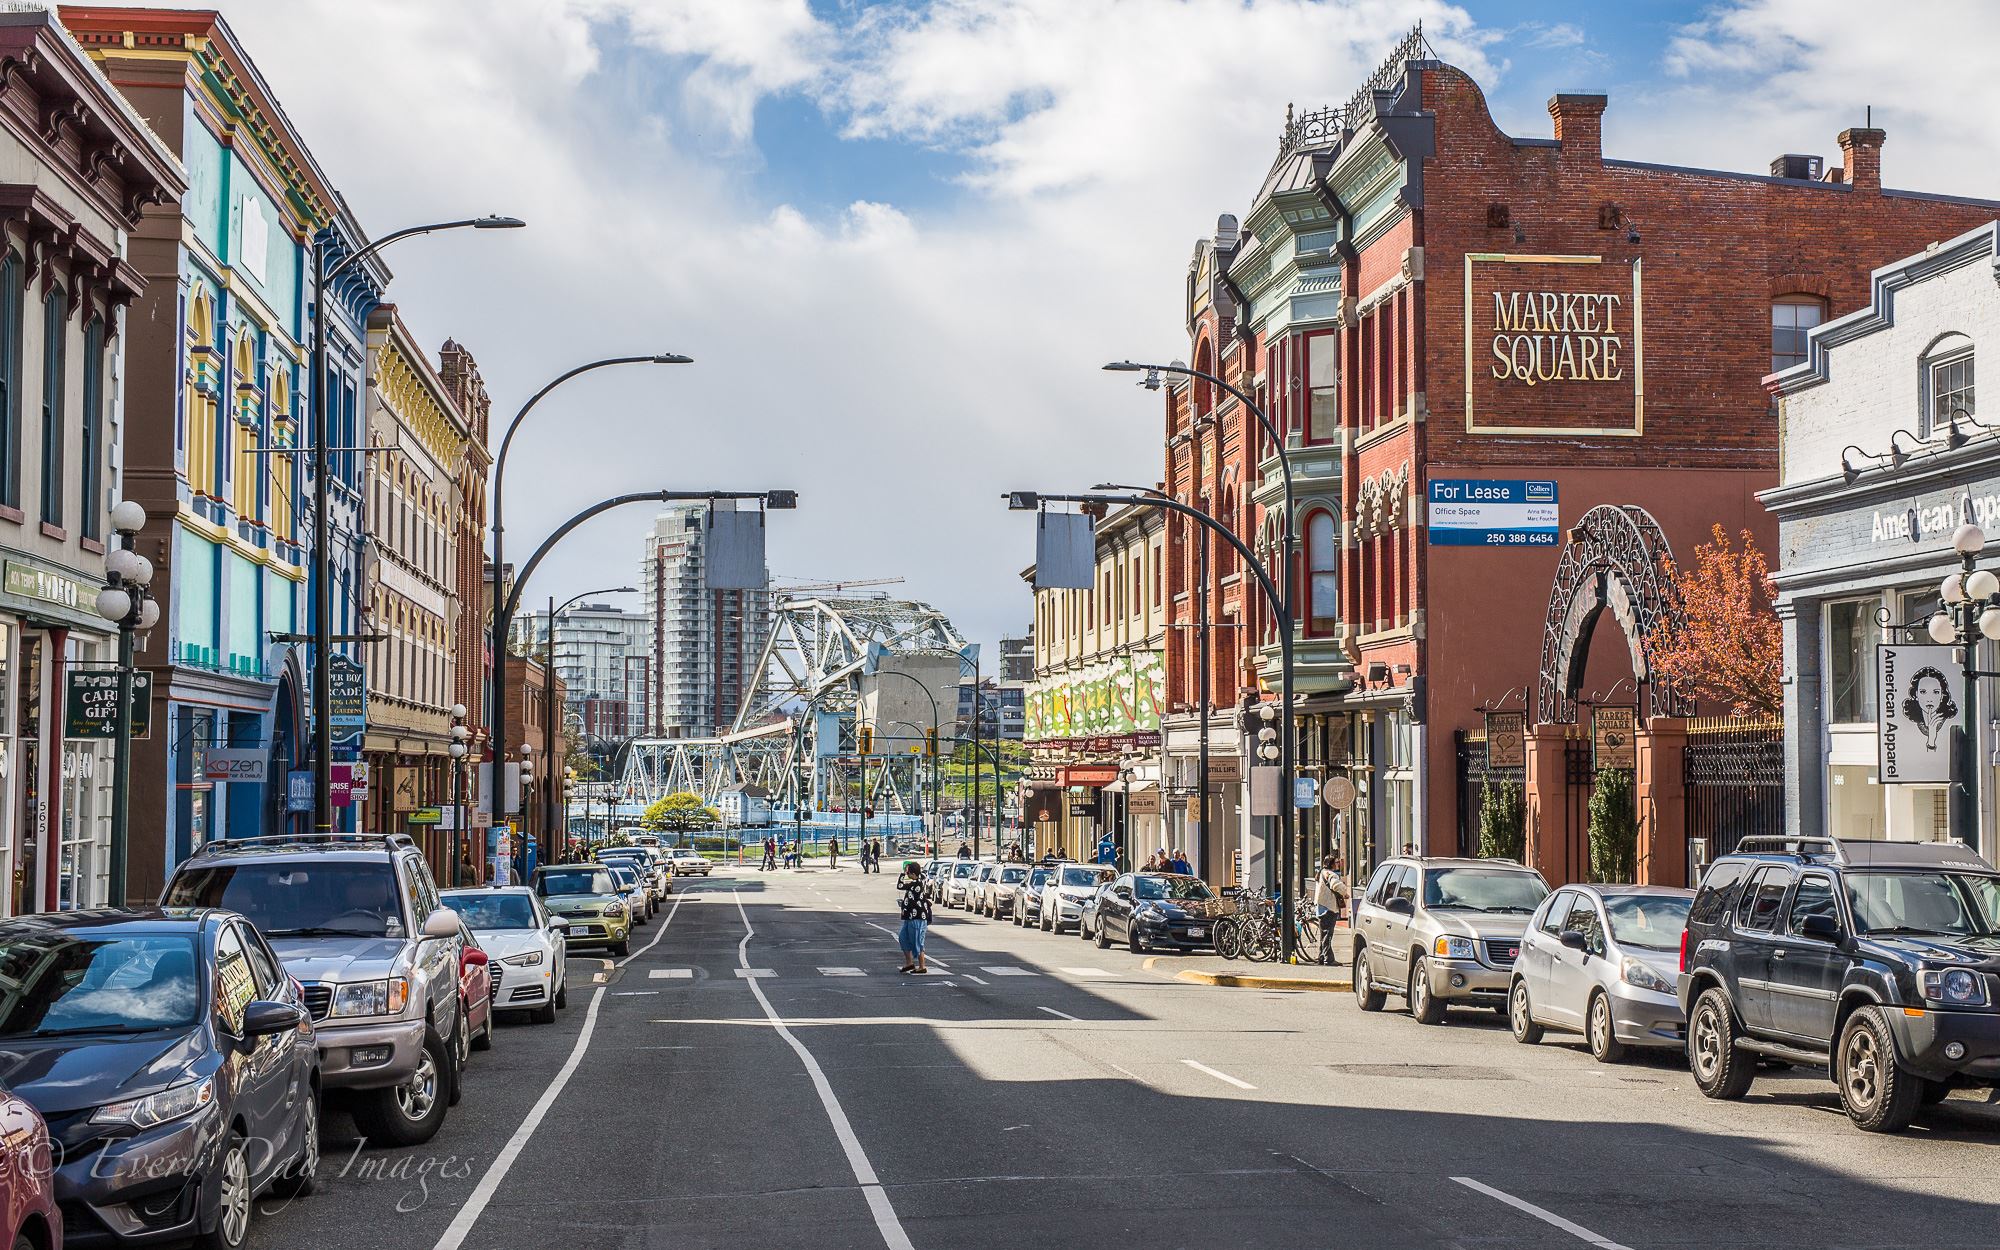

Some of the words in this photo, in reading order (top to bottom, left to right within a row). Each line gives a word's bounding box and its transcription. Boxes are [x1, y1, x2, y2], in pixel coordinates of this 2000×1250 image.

[1492, 291, 1622, 334] MARKET
[1491, 334, 1623, 387] SQUARE
[1434, 483, 1460, 499] For
[1465, 483, 1510, 499] Lease
[1434, 507, 1456, 515] Office
[1458, 507, 1480, 516] Space
[1871, 502, 1955, 543] Ameican
[1486, 533, 1506, 543] 250
[1508, 533, 1526, 543] 388
[1529, 534, 1554, 543] 6454
[73, 675, 147, 688] ZYDEO
[346, 673, 362, 683] BOX
[1884, 649, 1898, 719] American
[1489, 715, 1520, 726] MARKET
[1598, 711, 1631, 721] MARKET
[1489, 724, 1520, 734] SQUARE
[1598, 720, 1631, 730] SQUARE
[1883, 722, 1899, 778] Apparel
[205, 752, 263, 772] kazen
[39, 801, 47, 833] 565
[1104, 847, 1110, 855] P
[1941, 860, 1985, 869] NISSAN
